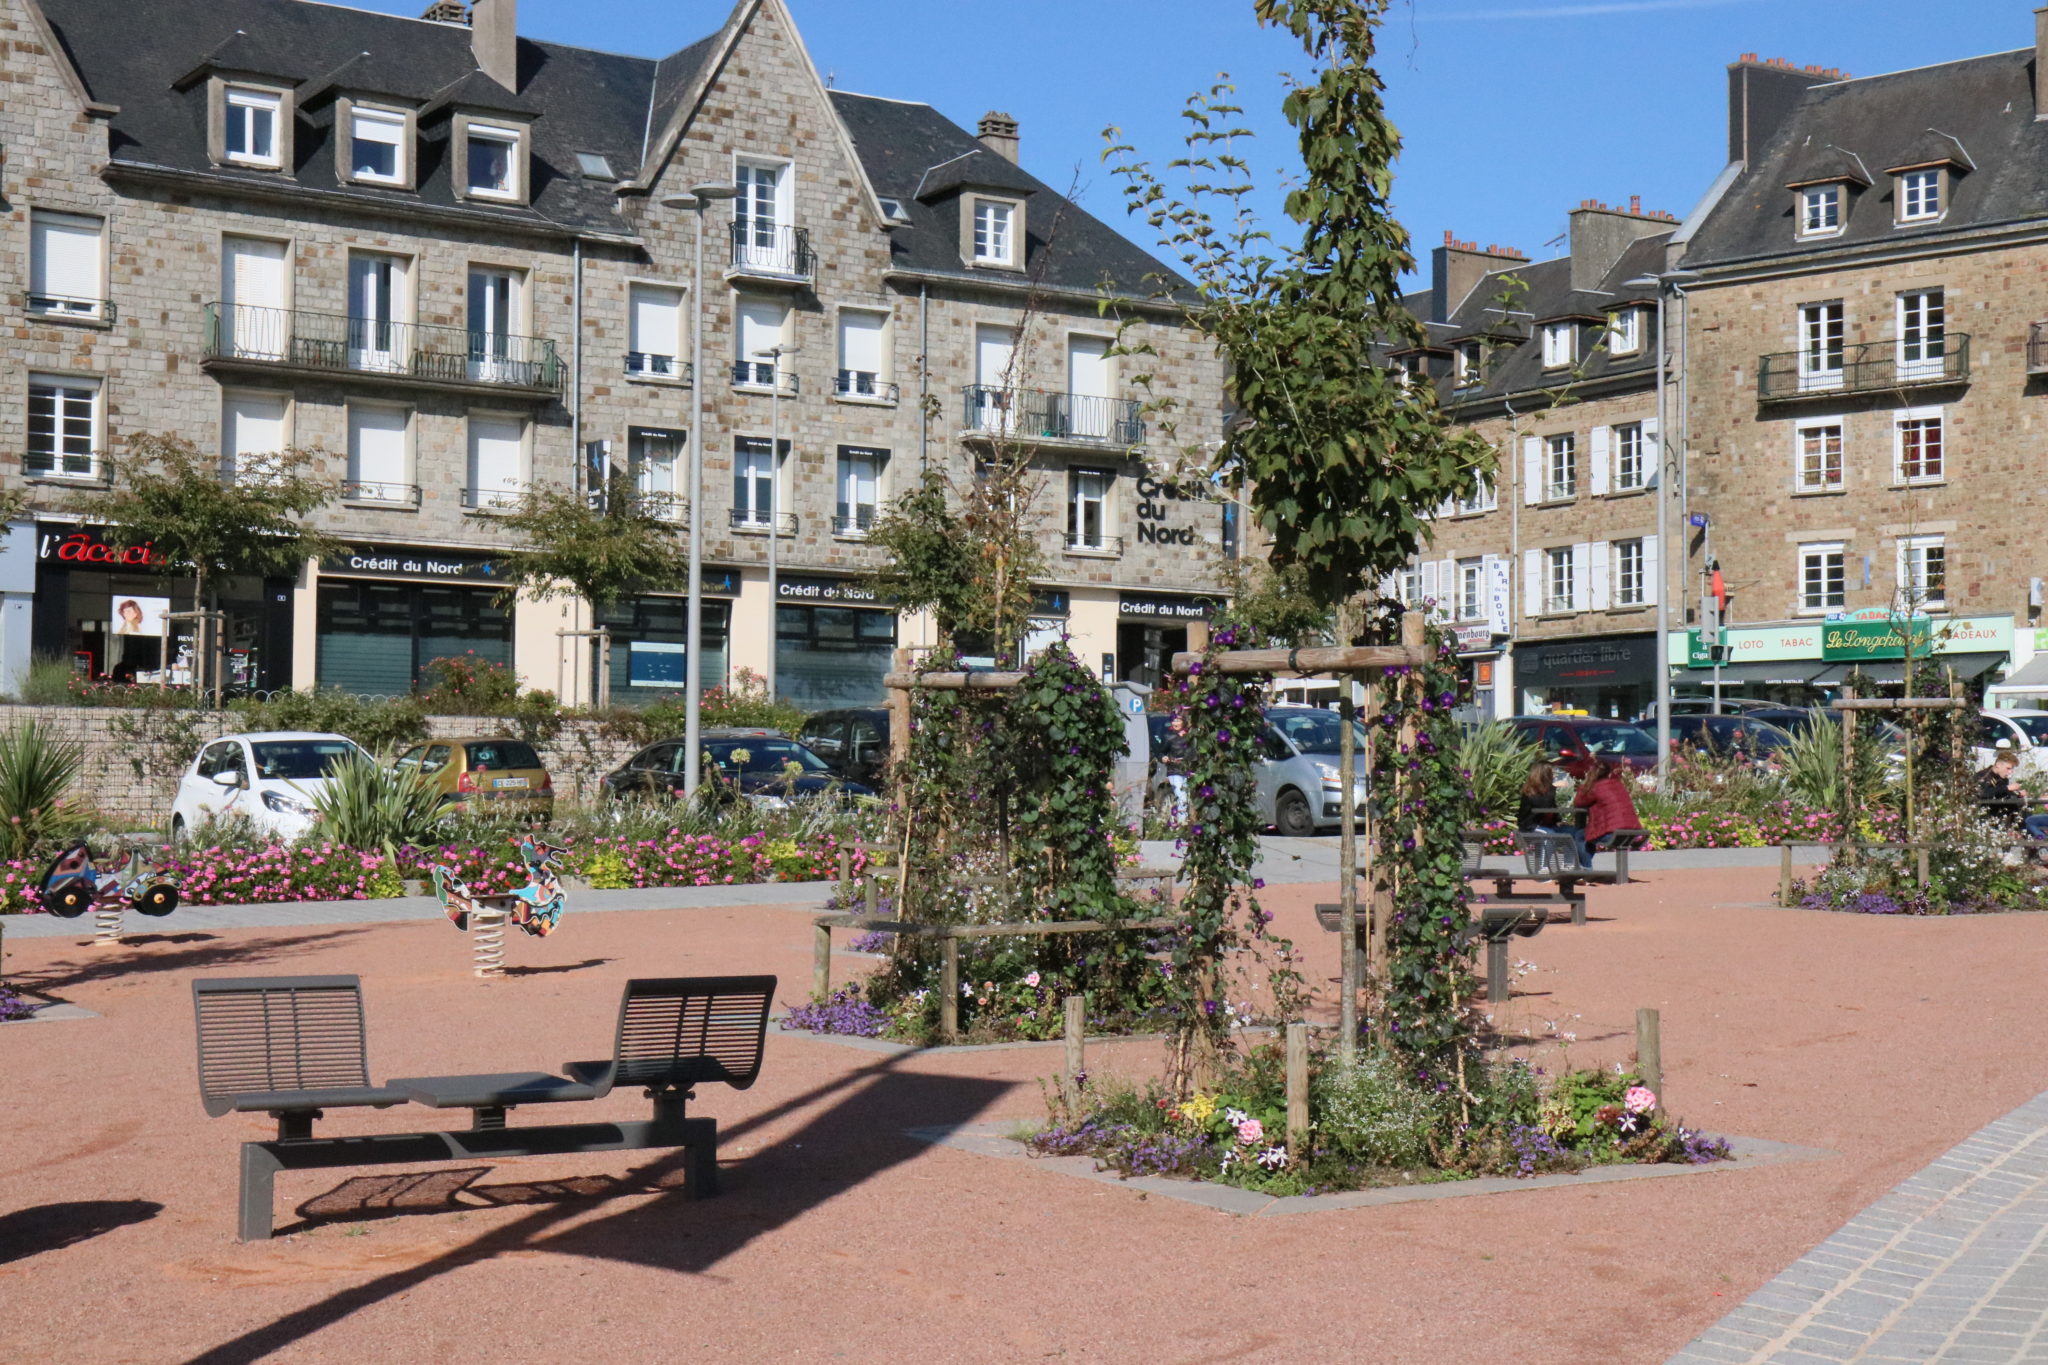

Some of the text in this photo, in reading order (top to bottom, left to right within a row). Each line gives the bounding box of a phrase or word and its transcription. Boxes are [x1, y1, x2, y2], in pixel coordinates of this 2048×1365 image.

[1136, 498, 1166, 521] du
[1137, 521, 1194, 546] Nord
[350, 556, 463, 575] Crédit du Nord
[1494, 563, 1508, 585] BAR
[779, 584, 820, 597] Crédit
[1120, 602, 1204, 617] Crédit du Nord
[1494, 595, 1509, 633] BOULE
[1855, 611, 1890, 620] TABAC
[1458, 629, 1490, 640] nenbourg
[1826, 631, 1843, 649] Le
[1951, 628, 1998, 640] ADEAUX
[1738, 640, 1764, 650] LOTO
[1780, 638, 1814, 648] TABAC
[1543, 645, 1631, 669] quartier libre
